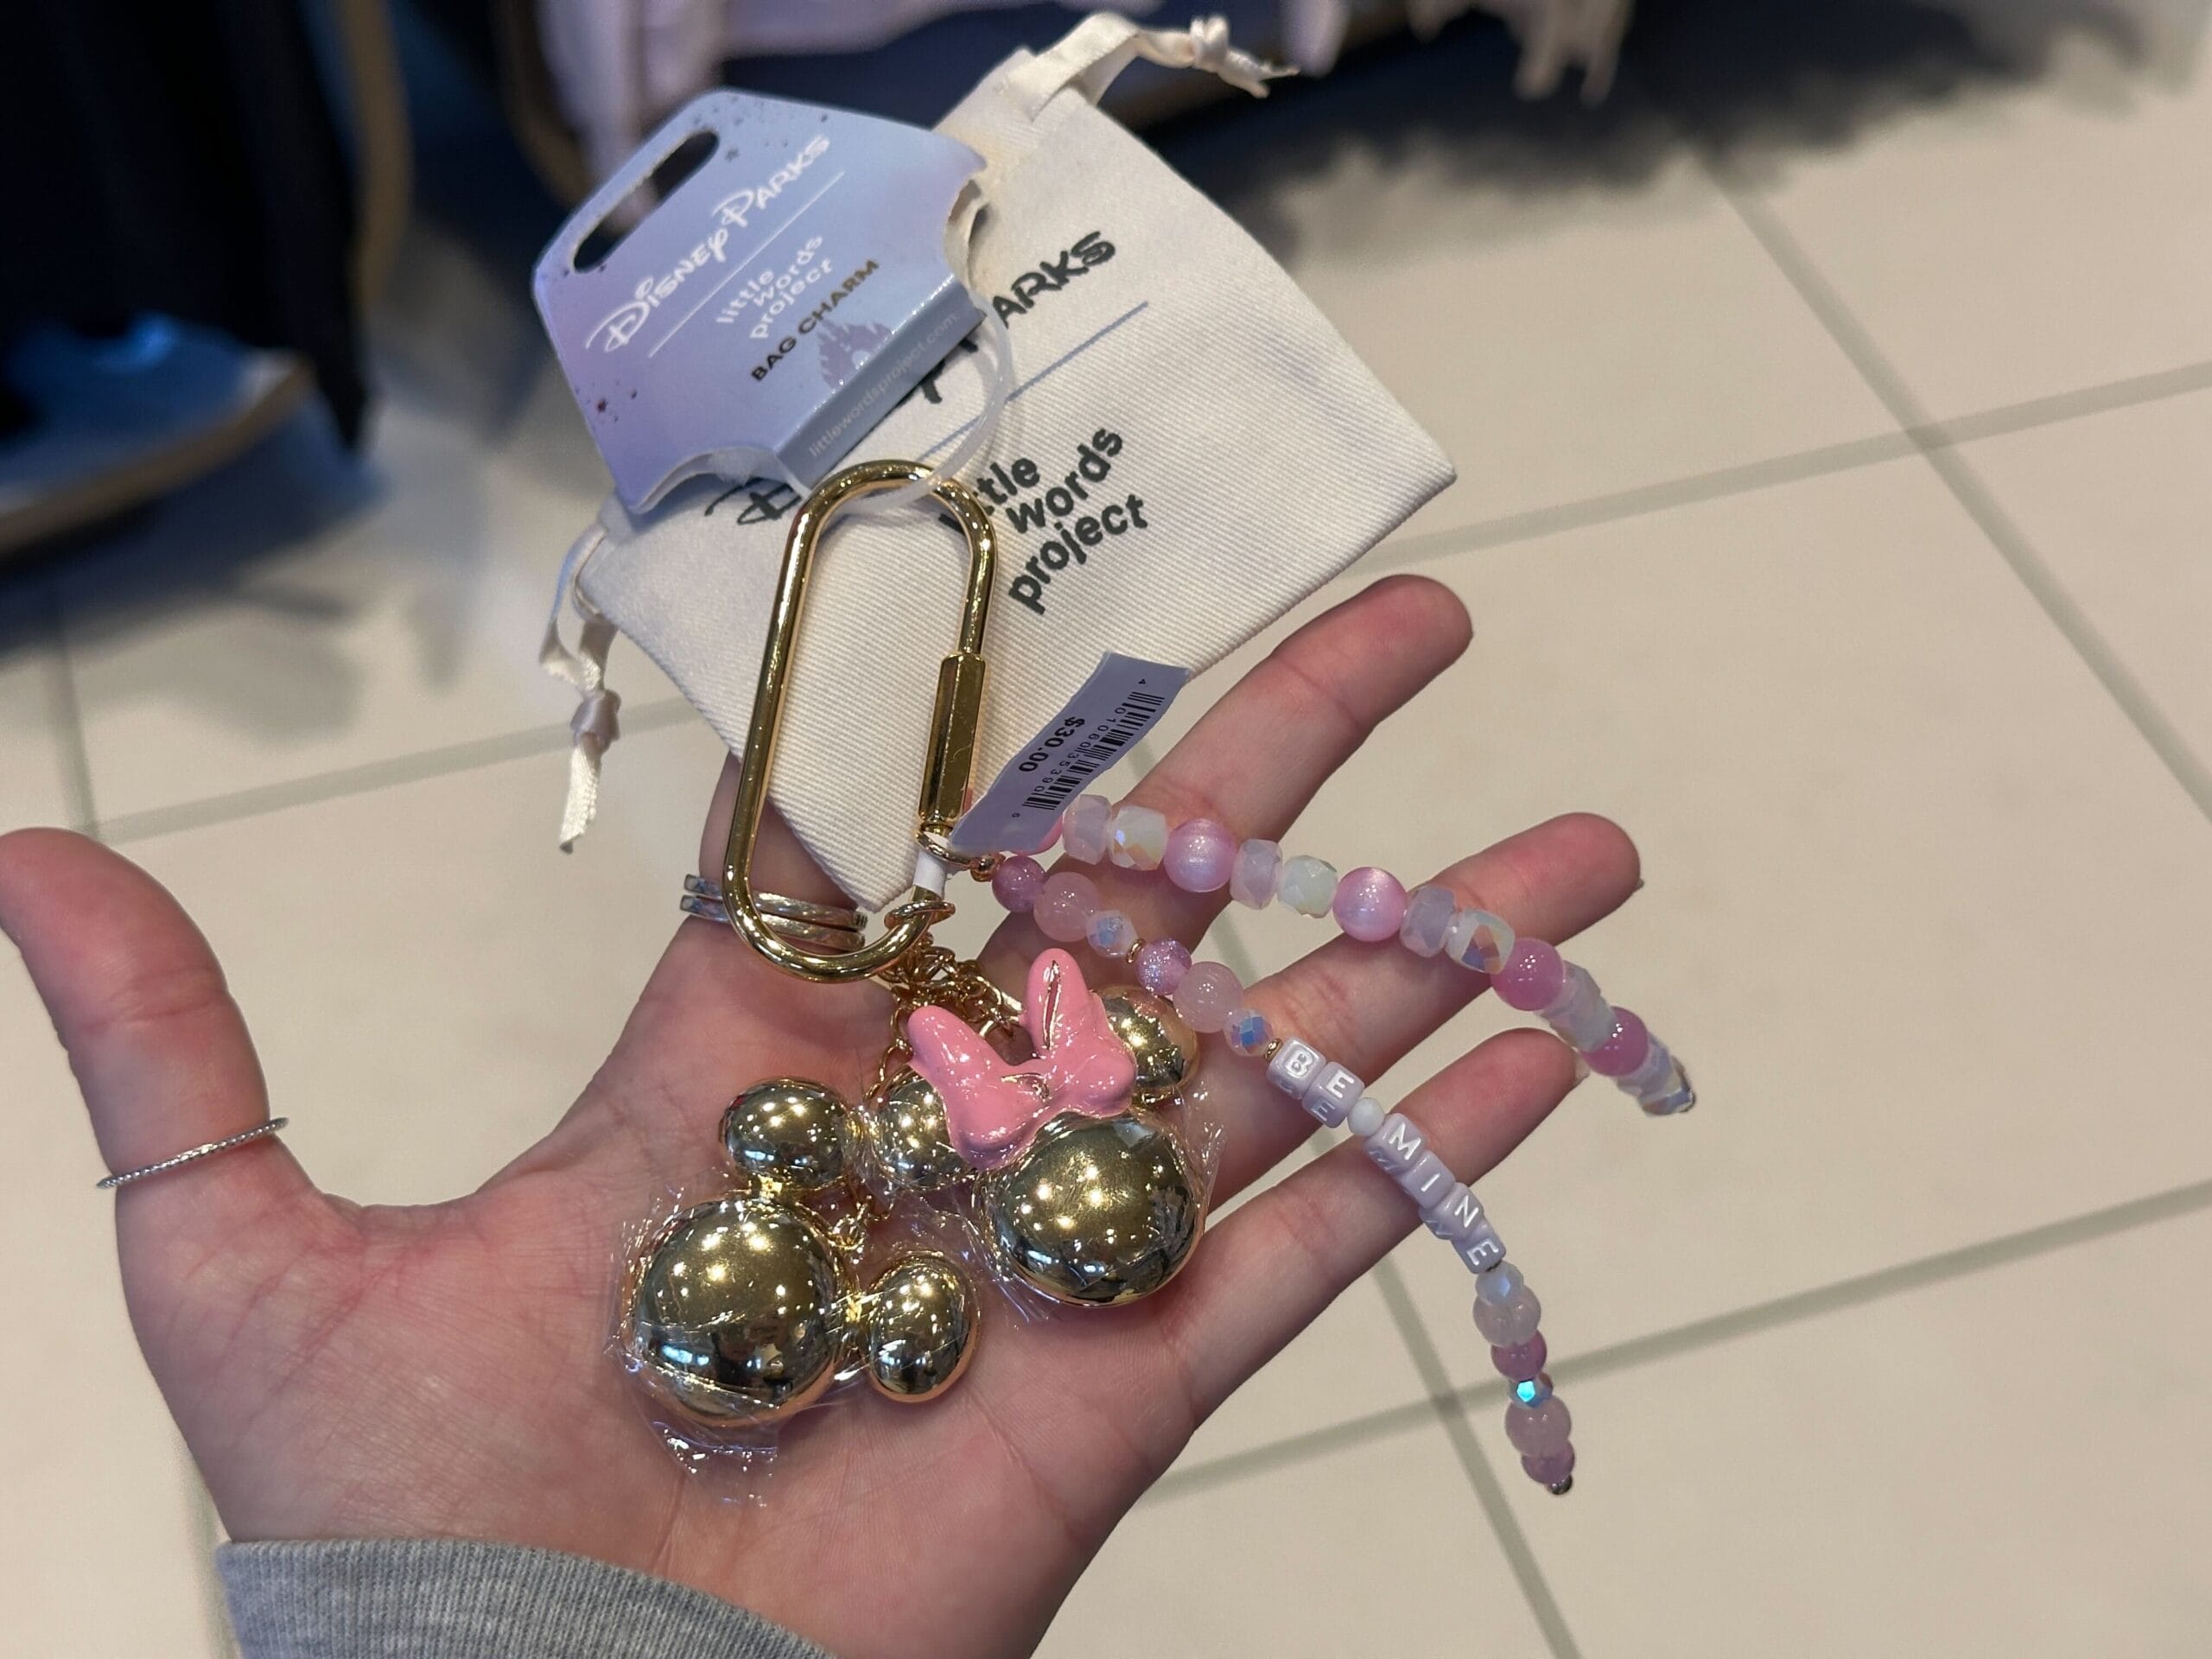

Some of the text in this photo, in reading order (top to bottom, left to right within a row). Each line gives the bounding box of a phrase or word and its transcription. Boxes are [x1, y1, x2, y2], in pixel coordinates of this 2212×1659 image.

[716, 270, 774, 323] little
[749, 258, 833, 338] project
[751, 259, 880, 382] BAG CHARM
[753, 236, 823, 306] words
[976, 231, 1116, 340] ARKS
[1005, 429, 1123, 533] words
[1009, 493, 1148, 615] project
[1018, 716, 1085, 772] $30.00
[1285, 1048, 1500, 1266] BE MINE
